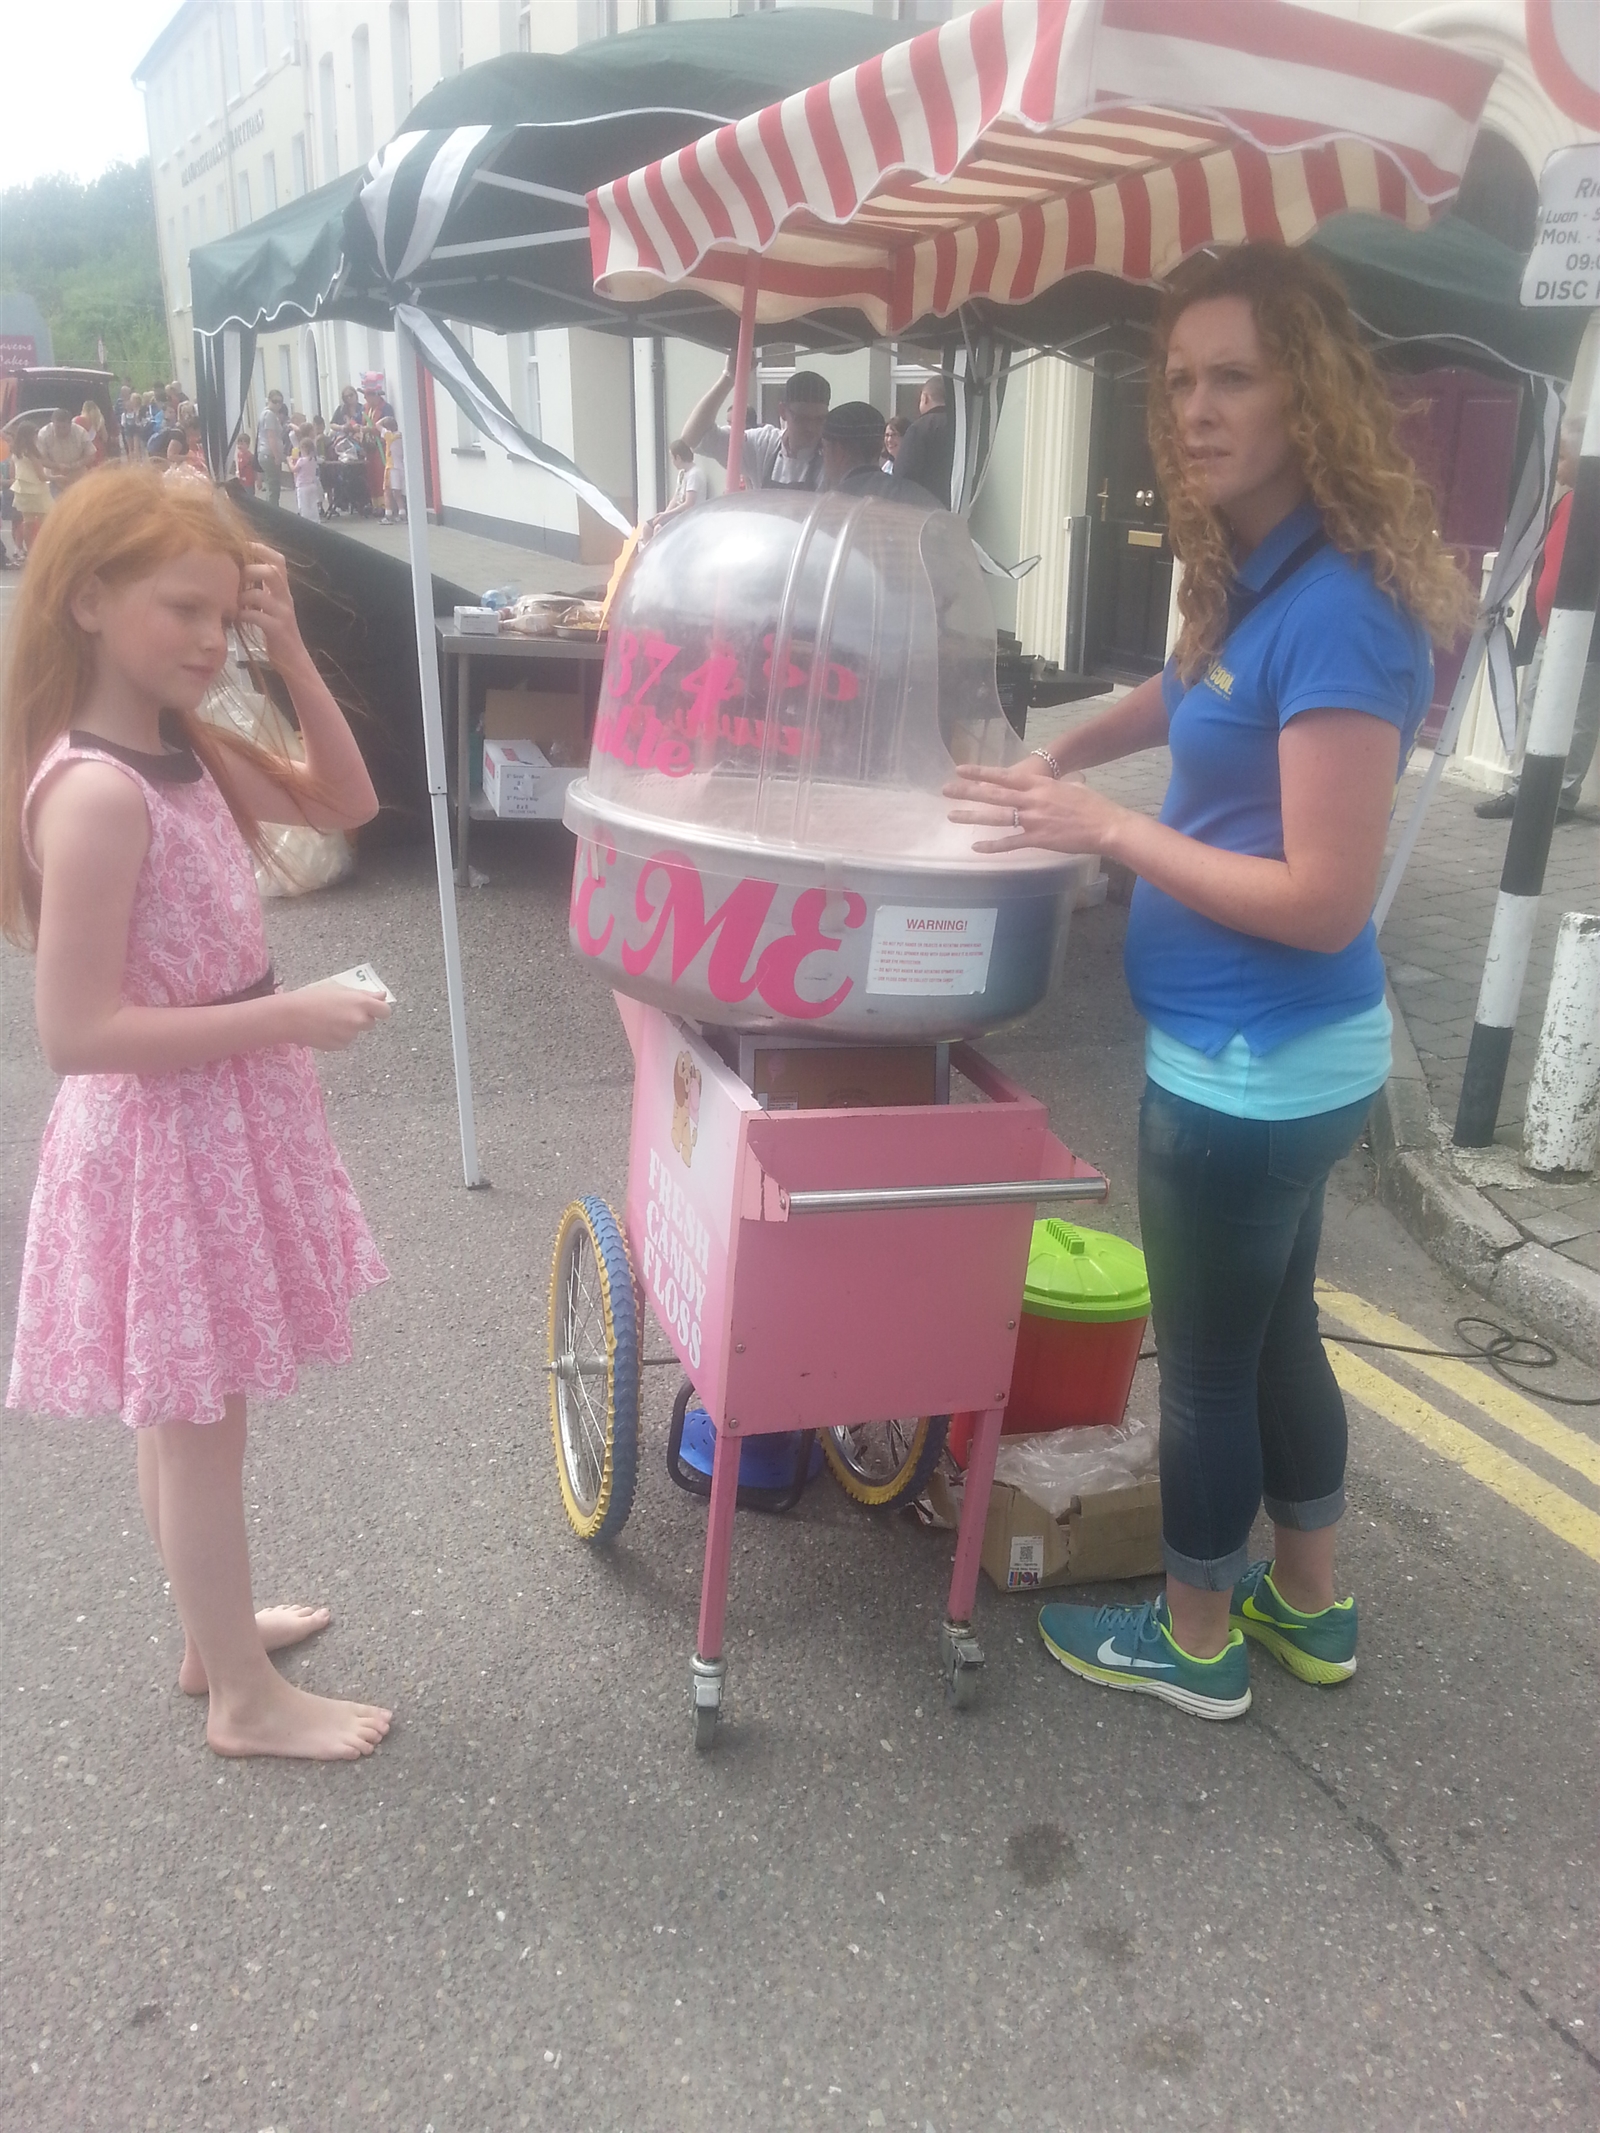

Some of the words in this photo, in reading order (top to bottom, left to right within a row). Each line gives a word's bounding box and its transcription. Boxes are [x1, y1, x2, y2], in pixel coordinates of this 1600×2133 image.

[1575, 178, 1600, 198] RI
[1545, 210, 1578, 224] Luan
[1541, 228, 1580, 244] MON.
[1566, 253, 1600, 270] 09:
[1535, 280, 1588, 300] DISC
[906, 918, 968, 931] WARNING!
[622, 851, 867, 1020] ME
[649, 1148, 710, 1275] FRESH
[646, 1200, 707, 1322] CANDY
[643, 1236, 702, 1369] FLOSS
